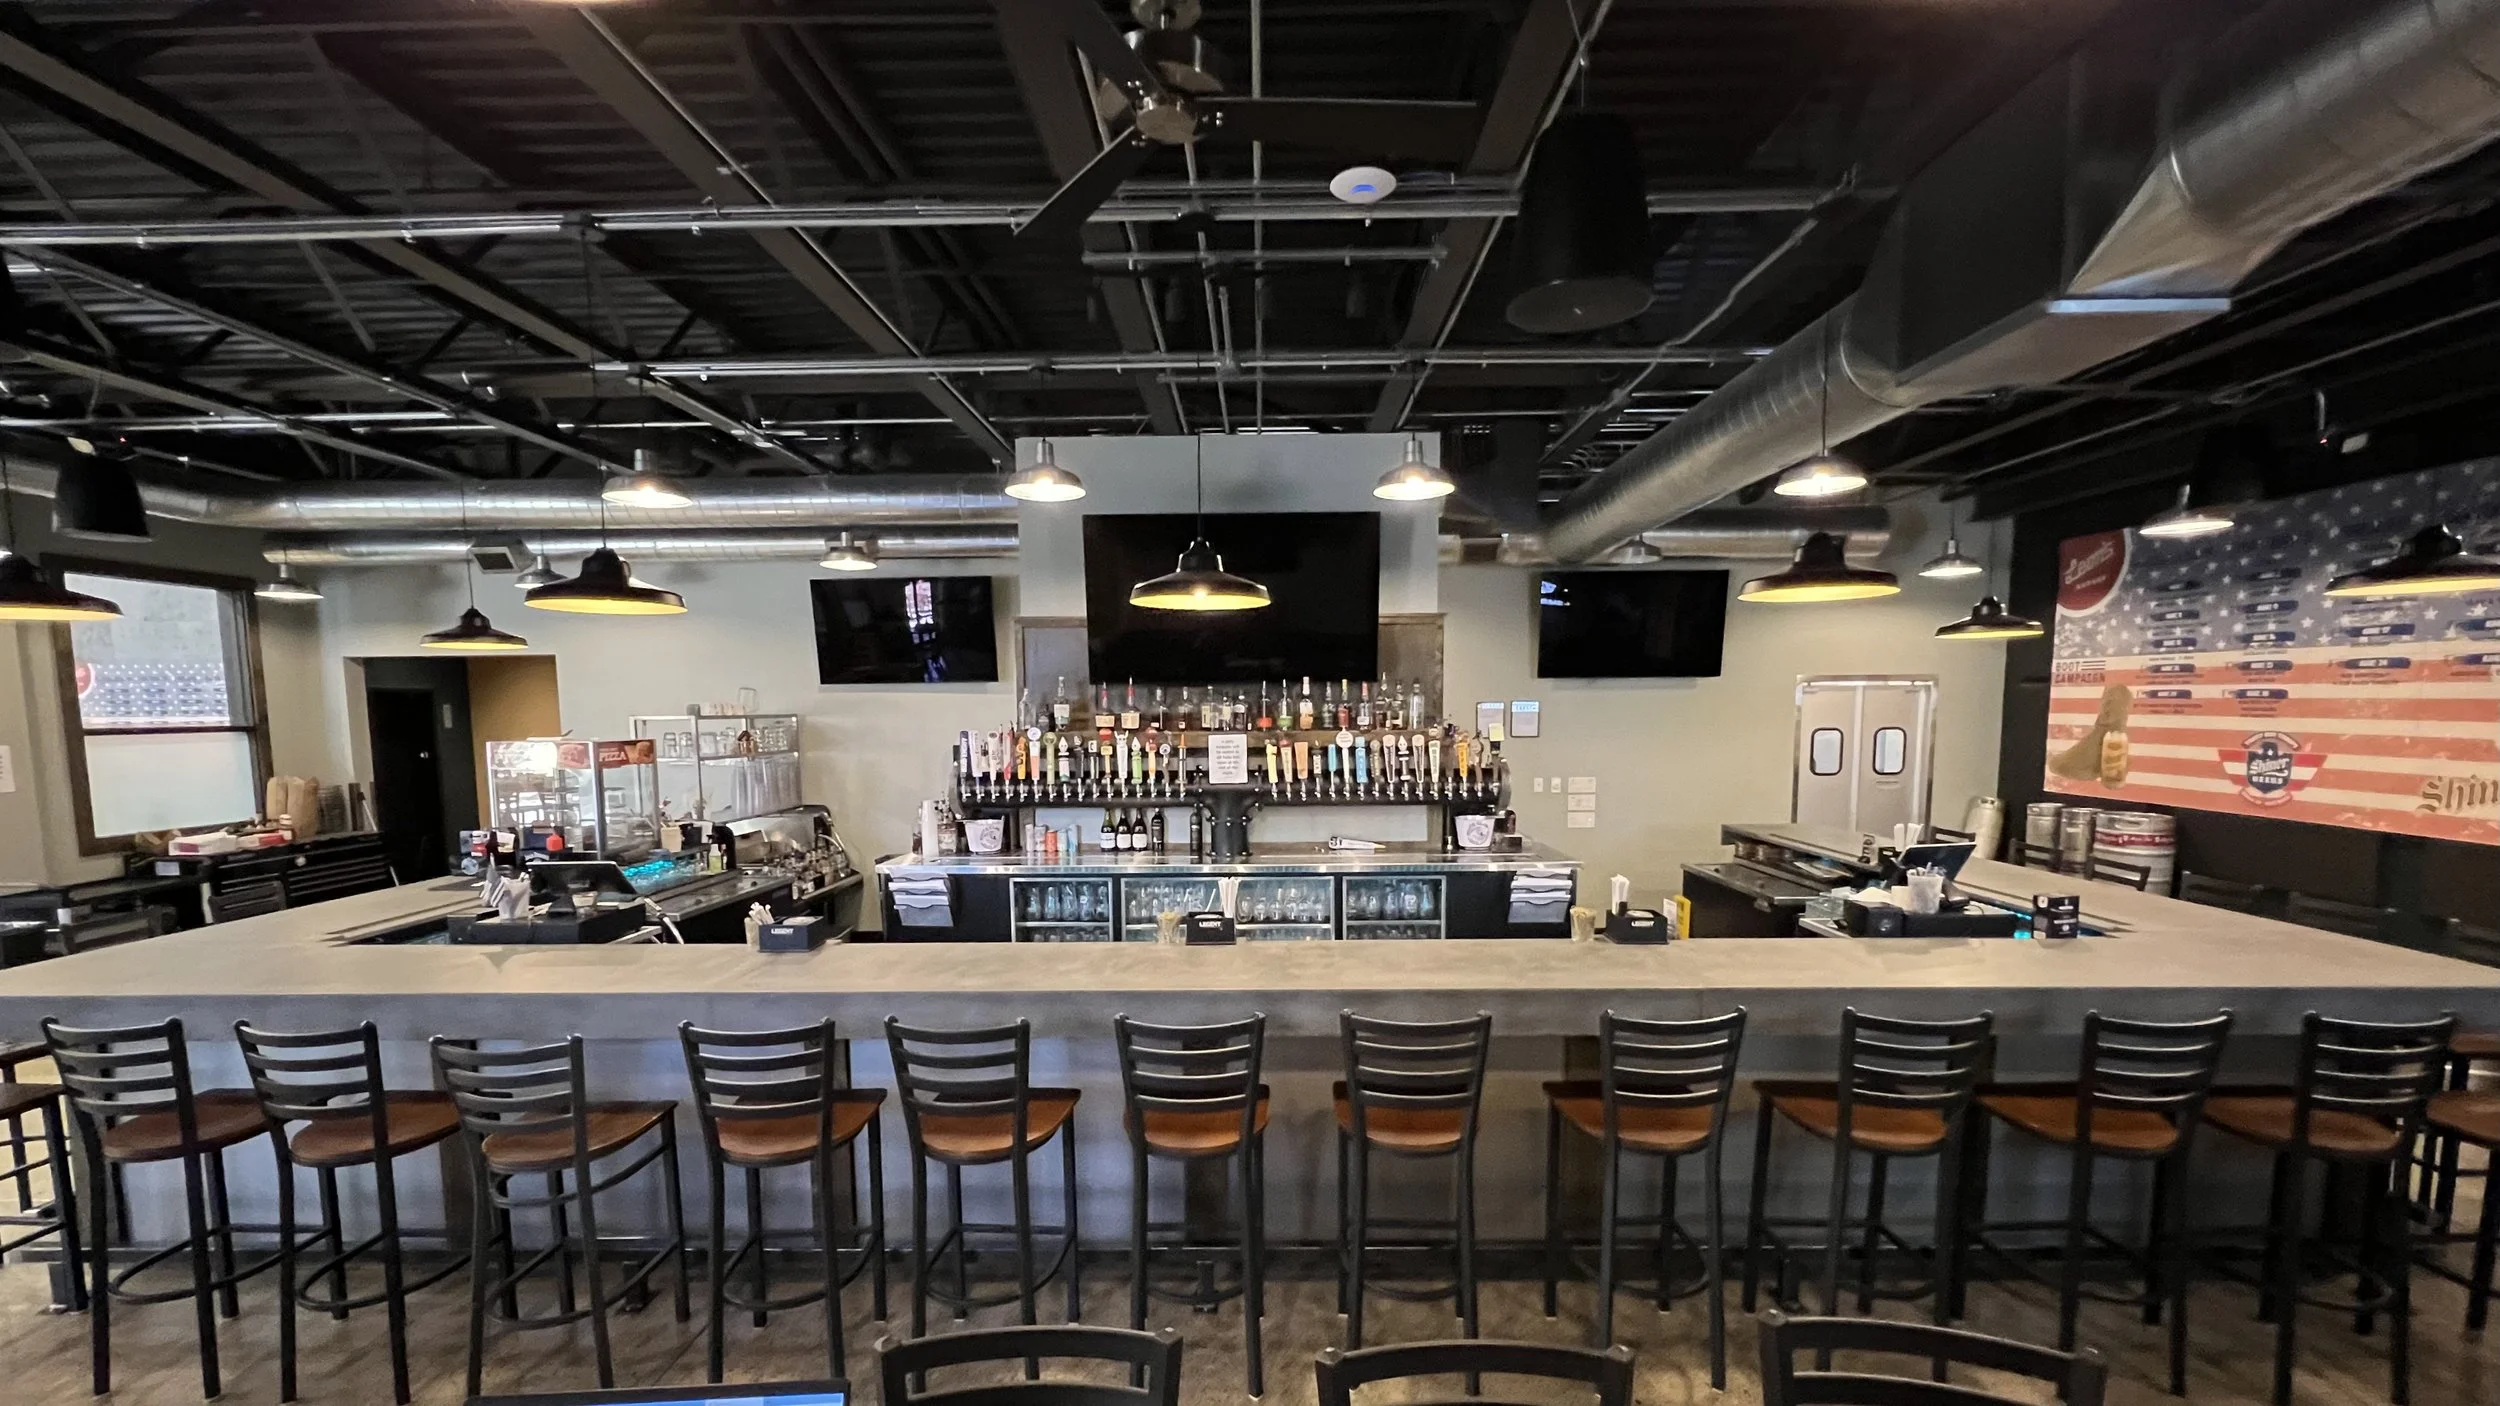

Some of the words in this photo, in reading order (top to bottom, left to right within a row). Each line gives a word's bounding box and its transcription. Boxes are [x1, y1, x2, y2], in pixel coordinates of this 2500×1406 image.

[2055, 661, 2081, 672] BOOT
[2054, 672, 2106, 684] CAMPAIGN
[599, 751, 627, 762] PIZZA
